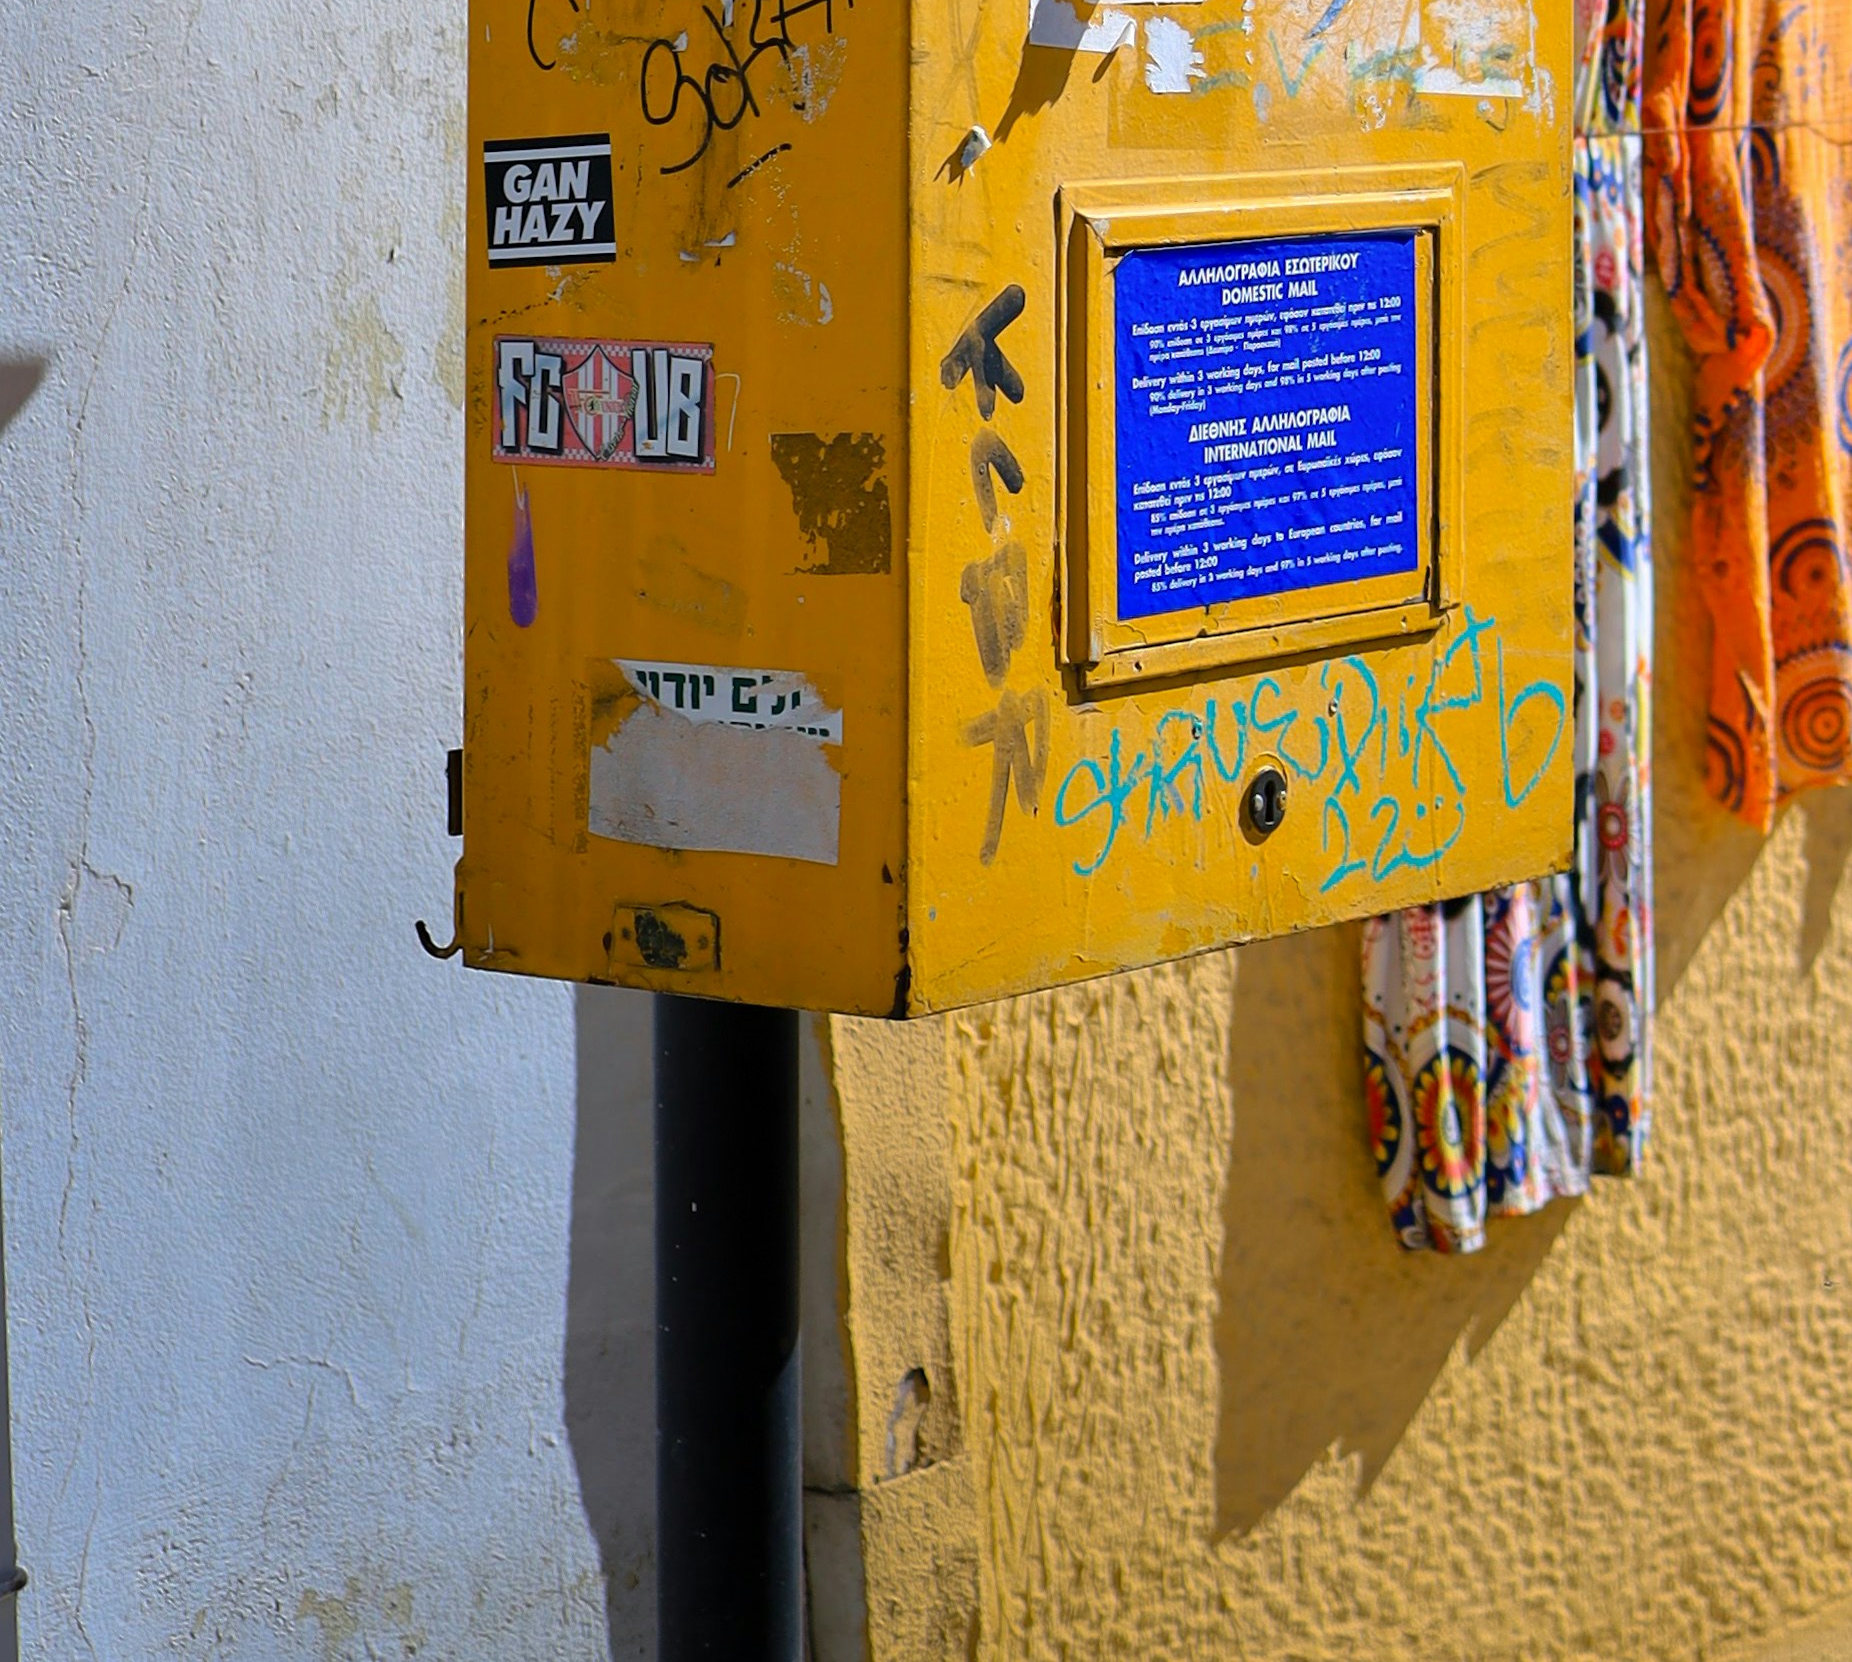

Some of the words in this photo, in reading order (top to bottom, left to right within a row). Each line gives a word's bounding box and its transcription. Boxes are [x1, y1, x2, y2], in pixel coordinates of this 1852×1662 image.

[503, 160, 590, 204] GAN
[493, 200, 606, 245] HAZY
[1178, 260, 1280, 286] ΑΛΛΗΛΟΓΡΑΦΙΑ
[1284, 252, 1360, 275] ΕΣΩΤΕΡΙΚΟΥ
[1221, 282, 1283, 305] DOMESTIC
[1287, 279, 1318, 298] MAIL
[1379, 295, 1401, 308] 12:00
[1132, 375, 1166, 389] Delivery
[1168, 370, 1194, 384] within
[1197, 369, 1203, 381] 3
[1205, 365, 1240, 379] working
[1267, 360, 1280, 372] for
[1281, 357, 1299, 370] mail
[1301, 353, 1328, 371] posted
[1330, 351, 1355, 364] before
[1358, 348, 1380, 361] 12:00
[1167, 388, 1195, 399] delivery
[1214, 381, 1243, 393] working
[1245, 379, 1262, 391] days
[1264, 376, 1277, 387] and
[1312, 369, 1340, 381] working
[1342, 367, 1358, 379] days
[499, 341, 563, 451] FC
[631, 348, 703, 458] UB
[1188, 418, 1247, 442] ΔΙΕΘΝΗΣ
[1251, 404, 1350, 433] ΑΛΛΗΛΟΓΡΑΦΙΑ
[1204, 434, 1302, 463] INTERNATIONAL
[1306, 429, 1336, 449] MAIL
[1208, 485, 1231, 499] 12:00
[1134, 550, 1168, 565] Delivery
[1172, 544, 1198, 558] within
[1202, 541, 1208, 553] 3
[1212, 536, 1247, 551] working
[1251, 533, 1271, 546] days
[1275, 531, 1284, 541] to
[1288, 525, 1325, 539] European
[1370, 514, 1382, 526] for
[1385, 510, 1402, 523] mail
[1134, 563, 1161, 583] posted
[1164, 561, 1191, 575] before
[1194, 555, 1217, 569] 12:00
[1169, 577, 1197, 589] delivery
[1215, 568, 1244, 580] working
[1246, 565, 1262, 577] days
[1264, 560, 1278, 572] and
[1313, 552, 1341, 563] working
[1342, 549, 1358, 560] days
